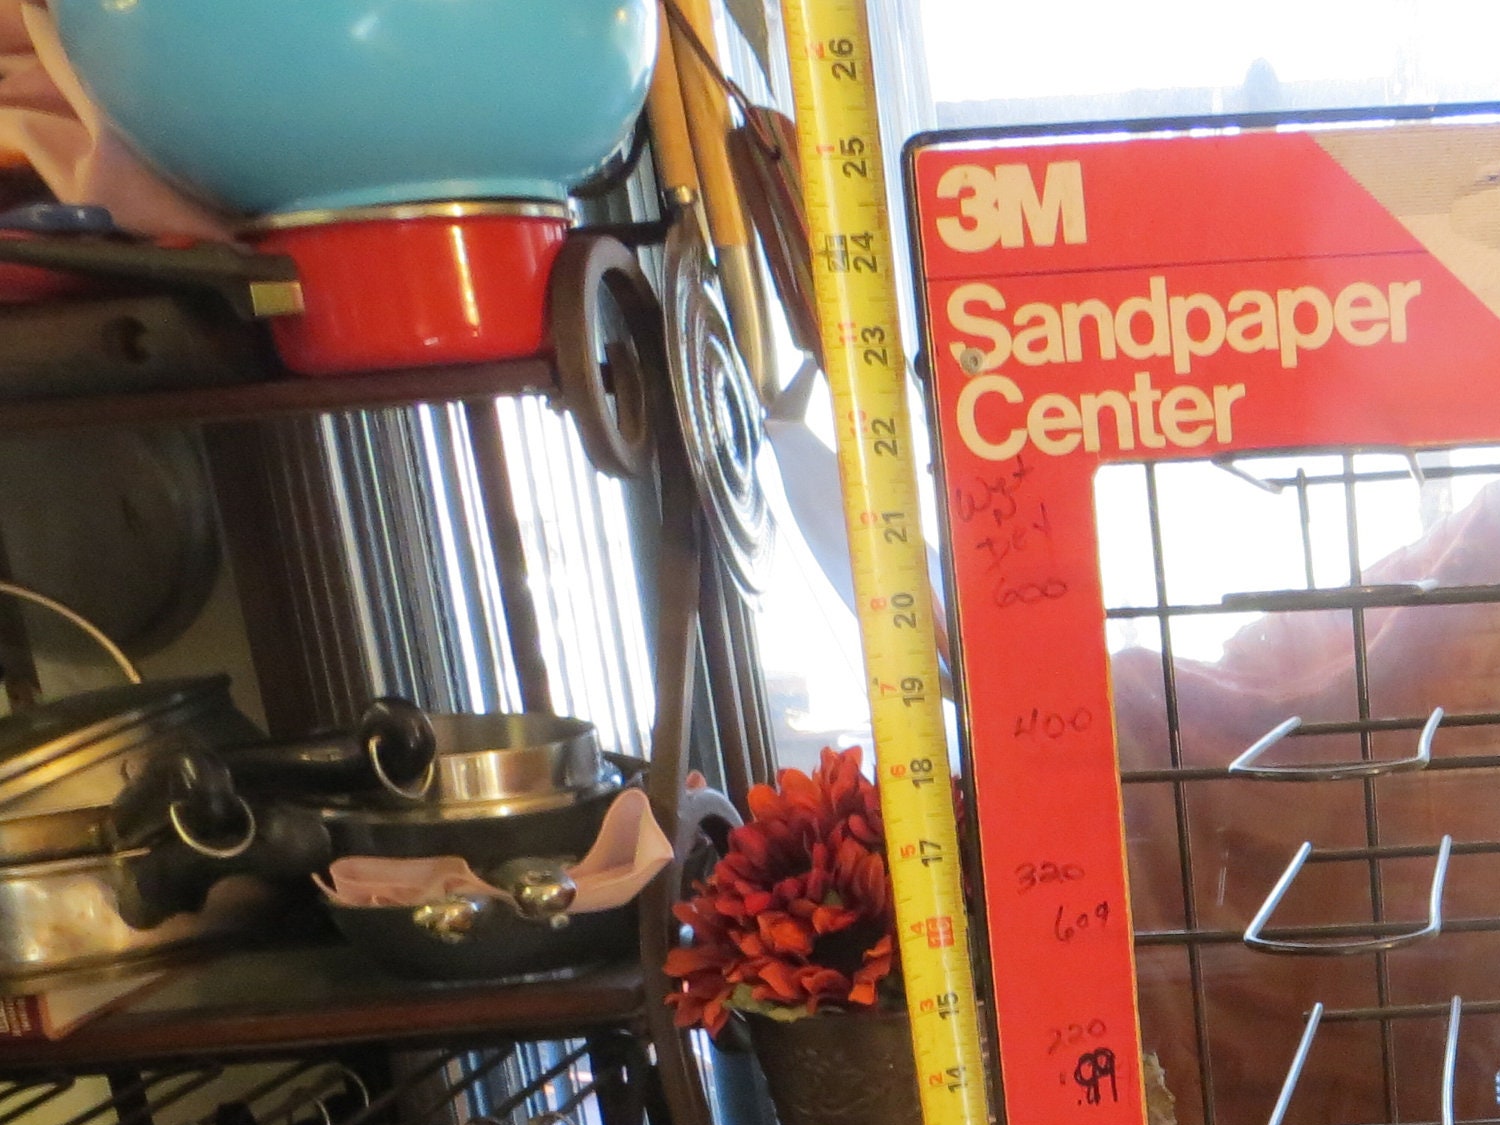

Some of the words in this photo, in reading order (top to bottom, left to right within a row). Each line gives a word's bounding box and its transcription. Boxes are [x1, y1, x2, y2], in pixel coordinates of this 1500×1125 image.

[829, 38, 857, 81] 26
[840, 137, 867, 178] 25
[936, 160, 1087, 253] 3M
[851, 232, 877, 273] 24
[947, 275, 1421, 374] Sandpaper
[861, 326, 888, 366] 23
[956, 371, 1245, 461] Center
[871, 418, 897, 457] 22
[882, 512, 907, 544] 21
[891, 592, 916, 629] 20
[880, 683, 896, 697] 7
[901, 677, 925, 708] 19
[1014, 708, 1092, 738] 400
[910, 759, 934, 789] 18
[900, 845, 916, 859] 5
[919, 840, 943, 868] 17
[911, 921, 925, 936] 4
[920, 998, 934, 1013] 3
[936, 992, 959, 1020] 15
[929, 1072, 943, 1088] 2
[946, 1066, 968, 1093] 14
